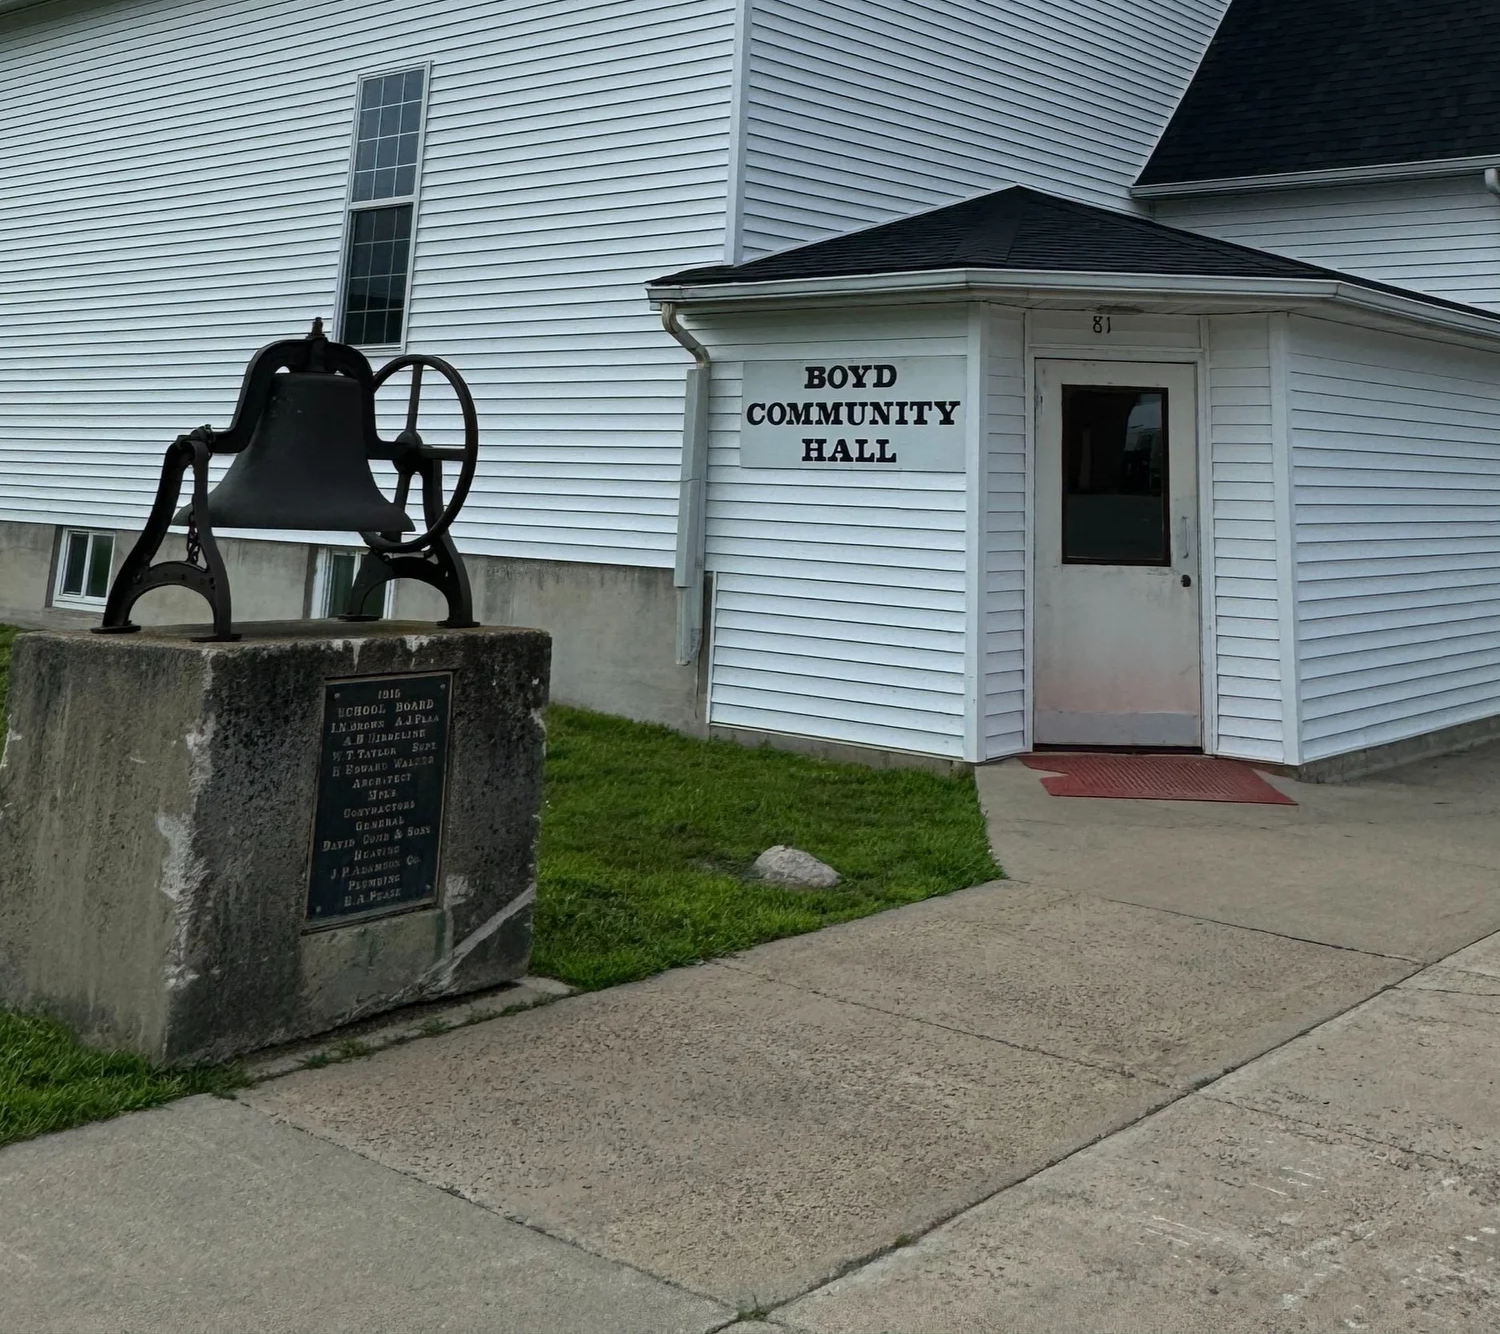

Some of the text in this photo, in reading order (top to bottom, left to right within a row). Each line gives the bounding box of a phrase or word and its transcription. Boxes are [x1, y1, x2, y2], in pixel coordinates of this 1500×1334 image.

[1092, 315, 1111, 334] 81
[803, 363, 898, 390] BOYD
[746, 400, 961, 426] COMMUNITY
[801, 438, 898, 463] HALL
[337, 699, 434, 717] SCHOOL BOARD
[352, 773, 412, 789] ARCHITECT
[343, 800, 416, 819] CONTRACTORS
[355, 816, 405, 831] GENERAL
[322, 839, 356, 851] DAVID
[393, 829, 403, 839] &
[354, 846, 400, 861] HEATING
[348, 874, 401, 891] PLUMBING
